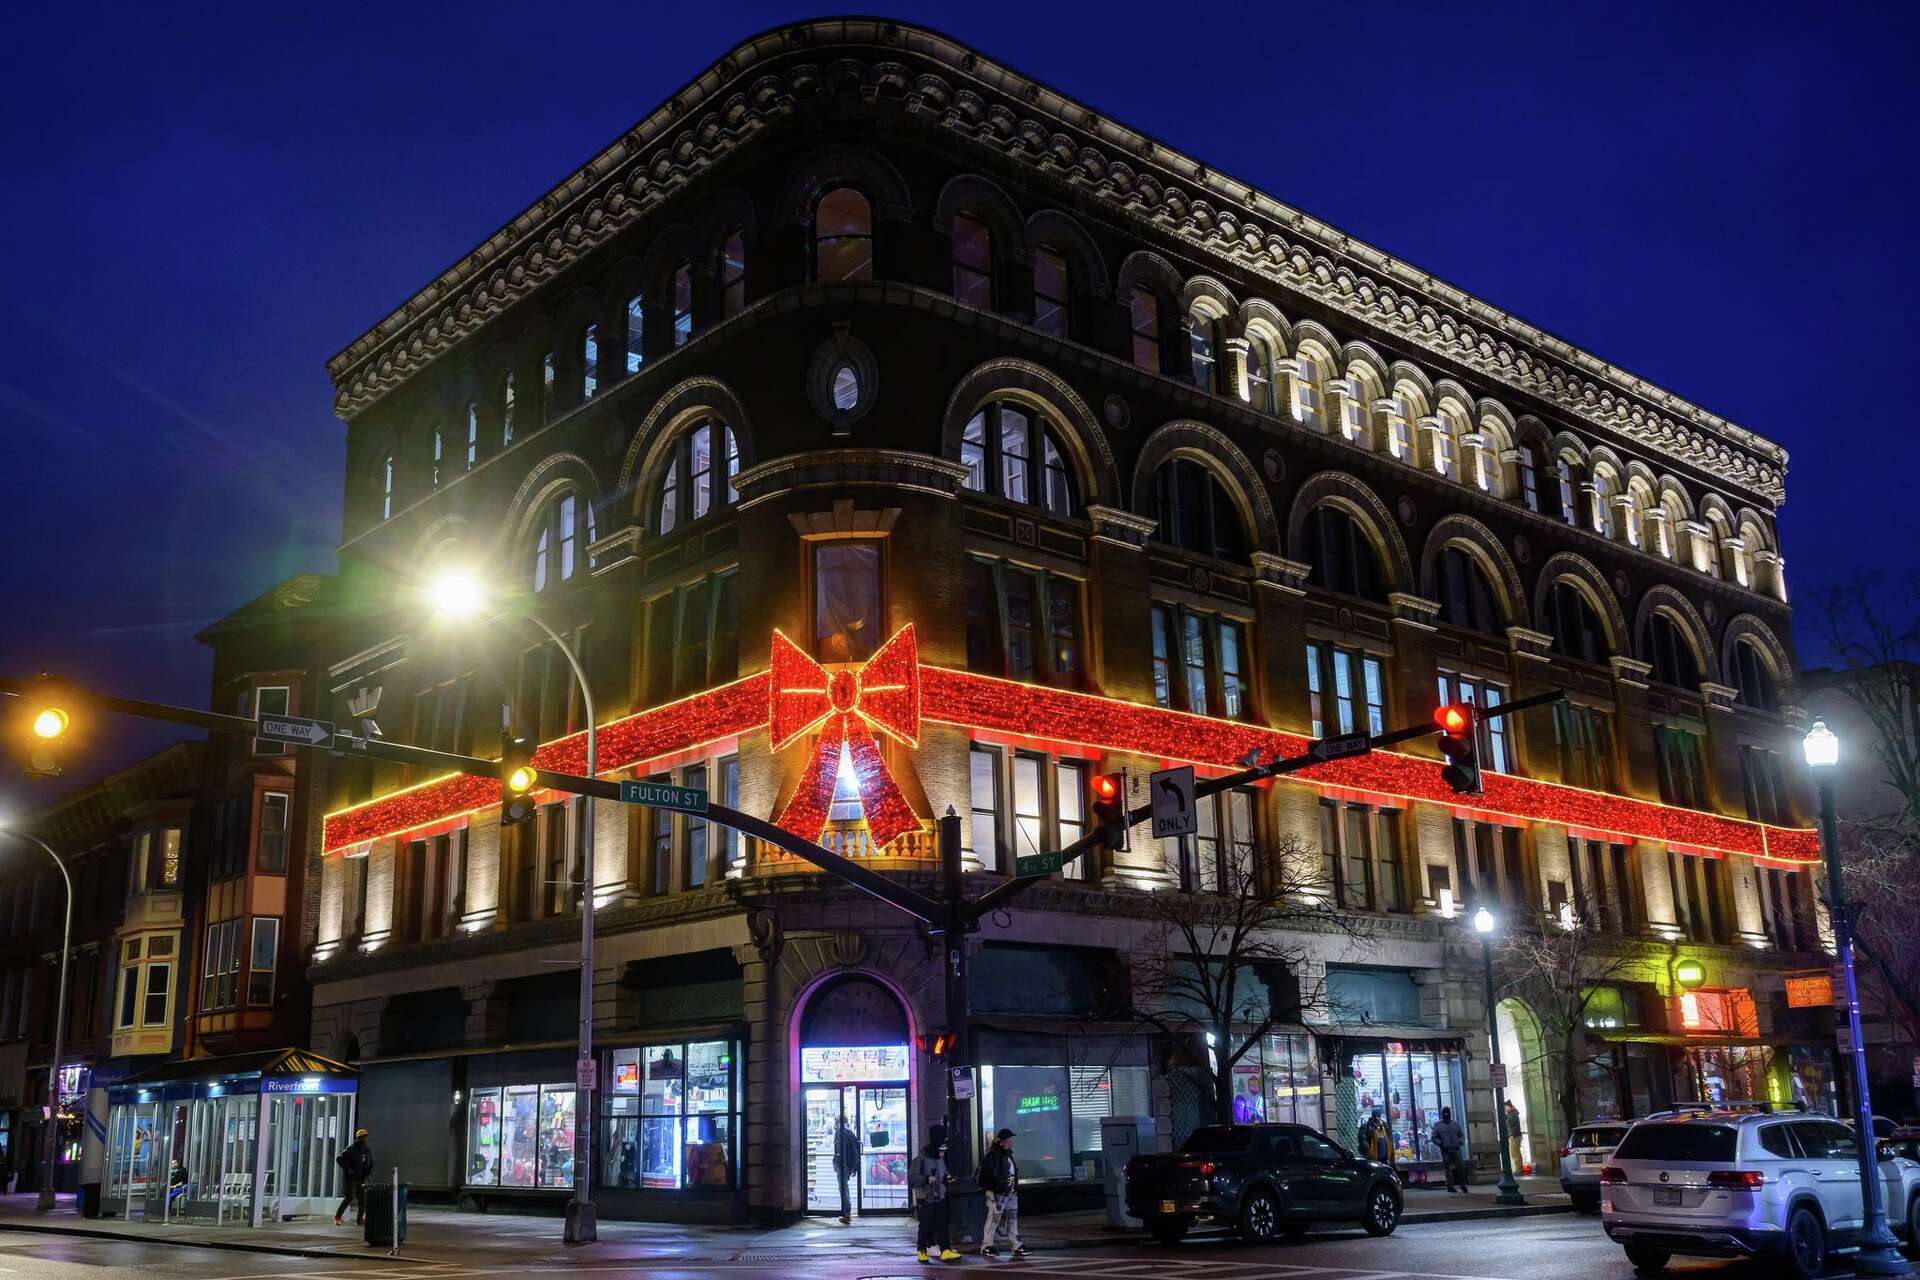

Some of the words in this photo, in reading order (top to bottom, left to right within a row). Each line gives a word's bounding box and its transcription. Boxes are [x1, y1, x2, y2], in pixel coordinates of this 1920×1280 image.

[265, 722, 287, 733] ONE
[291, 725, 312, 737] WAY
[630, 786, 679, 803] FULTON
[684, 793, 699, 806] ST
[1159, 815, 1190, 832] ONLY
[1042, 856, 1055, 870] ST
